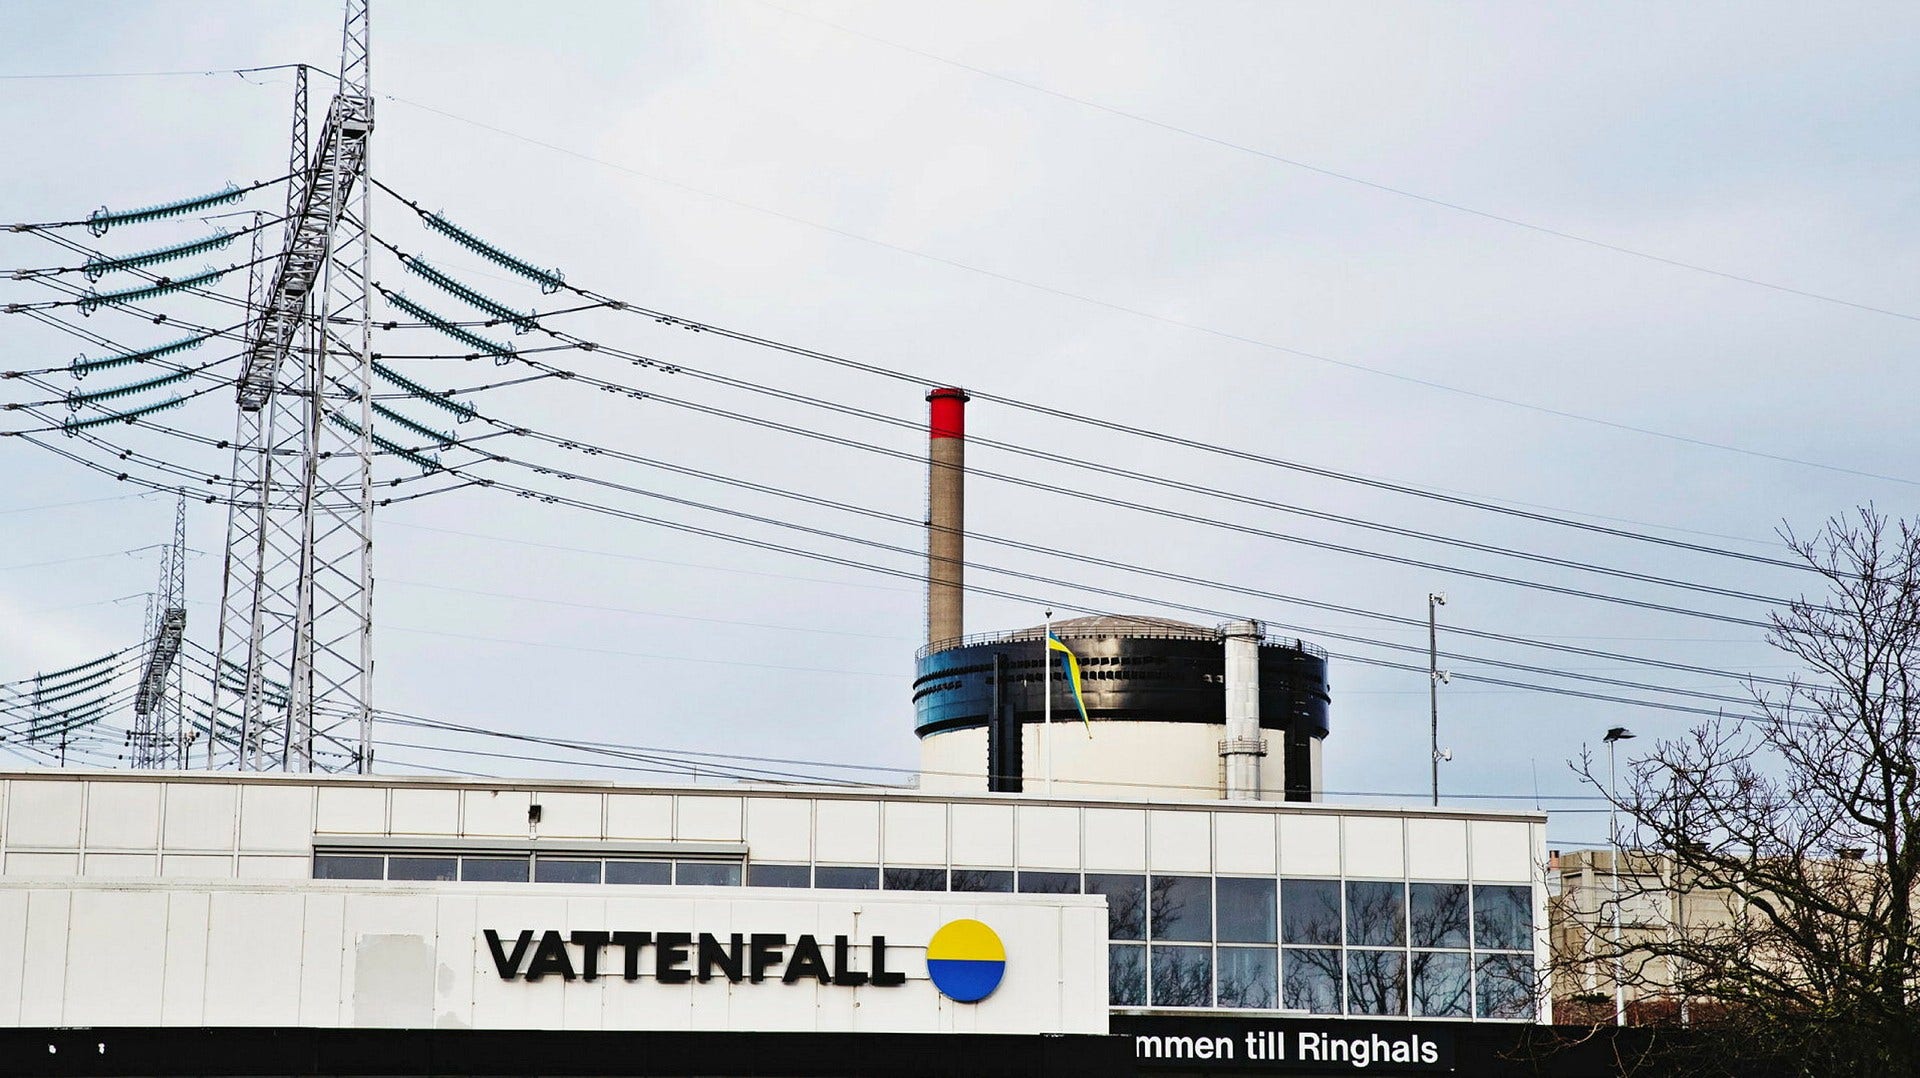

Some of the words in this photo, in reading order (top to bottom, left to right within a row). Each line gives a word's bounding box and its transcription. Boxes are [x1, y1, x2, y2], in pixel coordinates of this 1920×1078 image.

[484, 929, 906, 986] VATTENFALL
[1245, 1031, 1285, 1060] till
[1298, 1032, 1439, 1068] Ringhals
